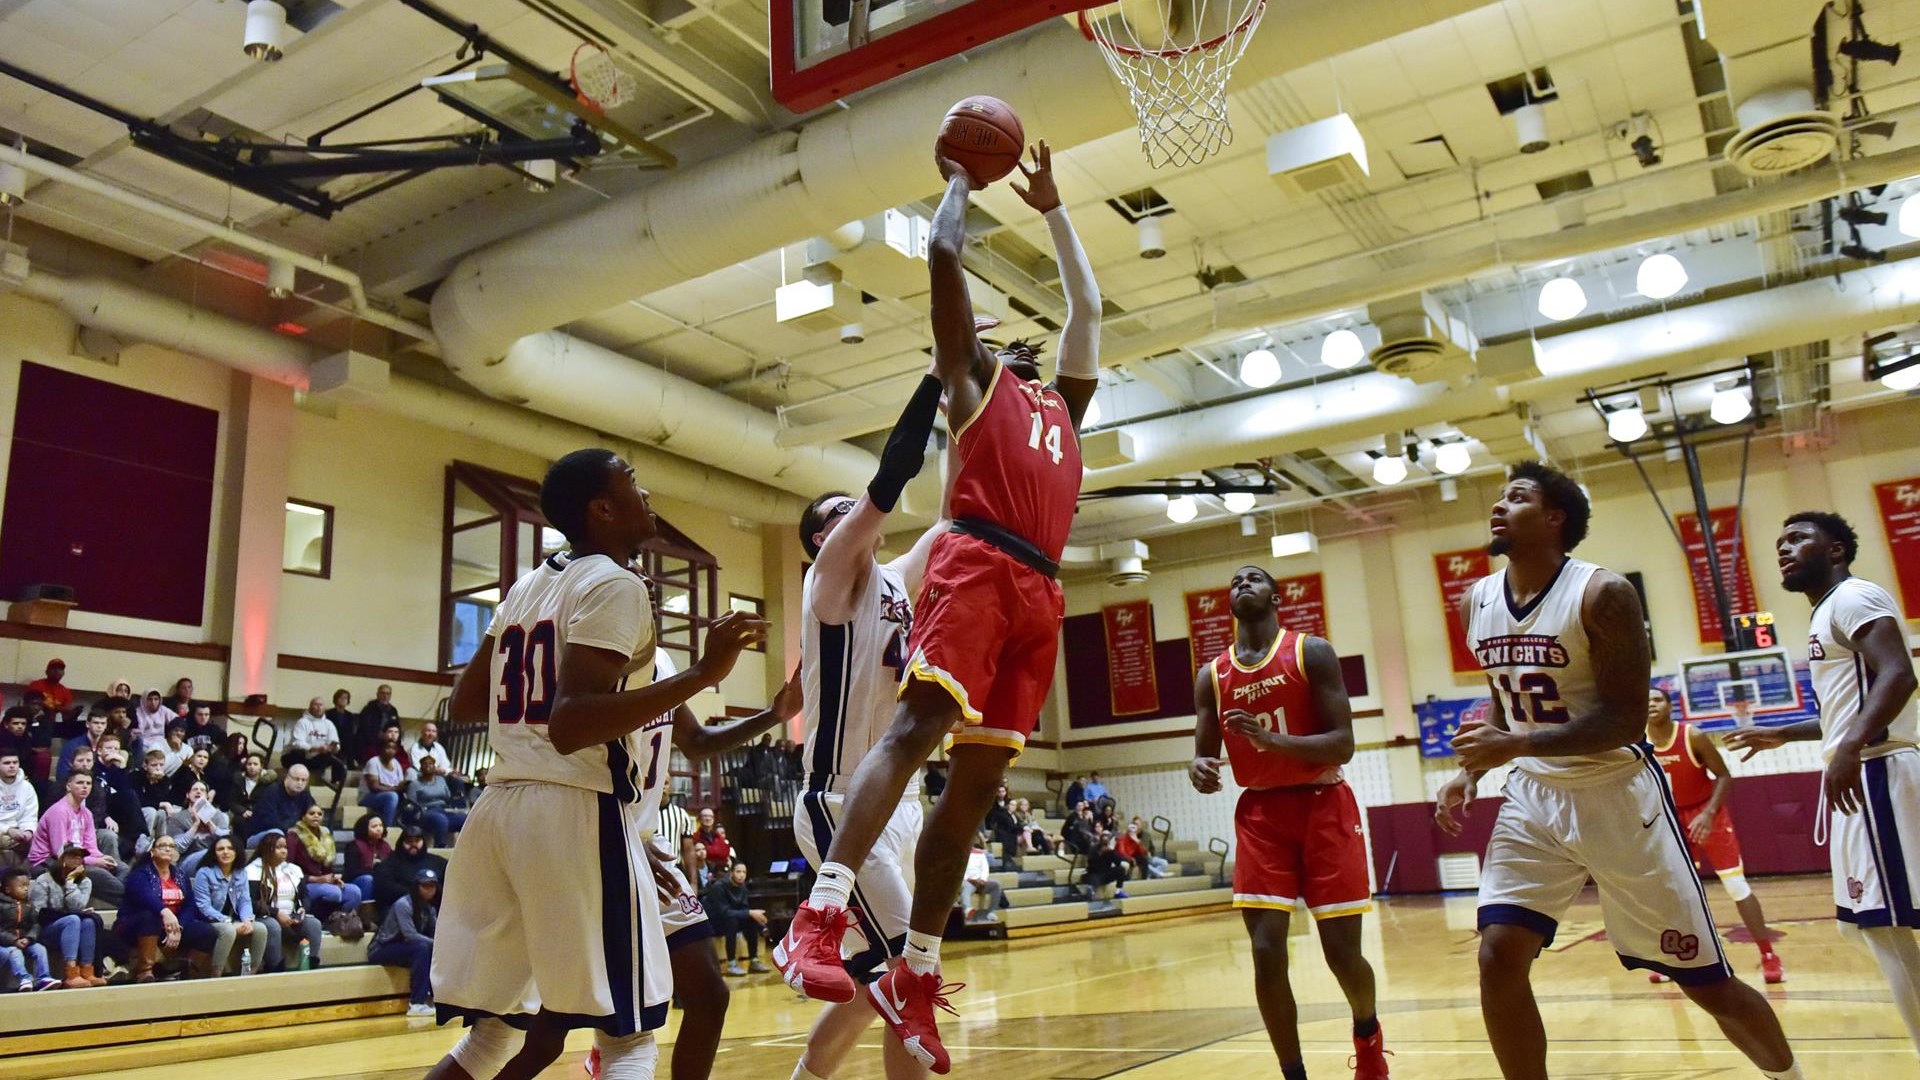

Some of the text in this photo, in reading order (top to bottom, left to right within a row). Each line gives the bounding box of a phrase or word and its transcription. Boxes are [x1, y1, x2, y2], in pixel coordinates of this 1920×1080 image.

[1028, 412, 1063, 465] 14
[1476, 644, 1565, 668] KNIGHTS
[1755, 626, 1772, 648] 6
[497, 619, 557, 725] 30
[1232, 674, 1288, 700] CHESTNUT
[1498, 672, 1570, 725] 12
